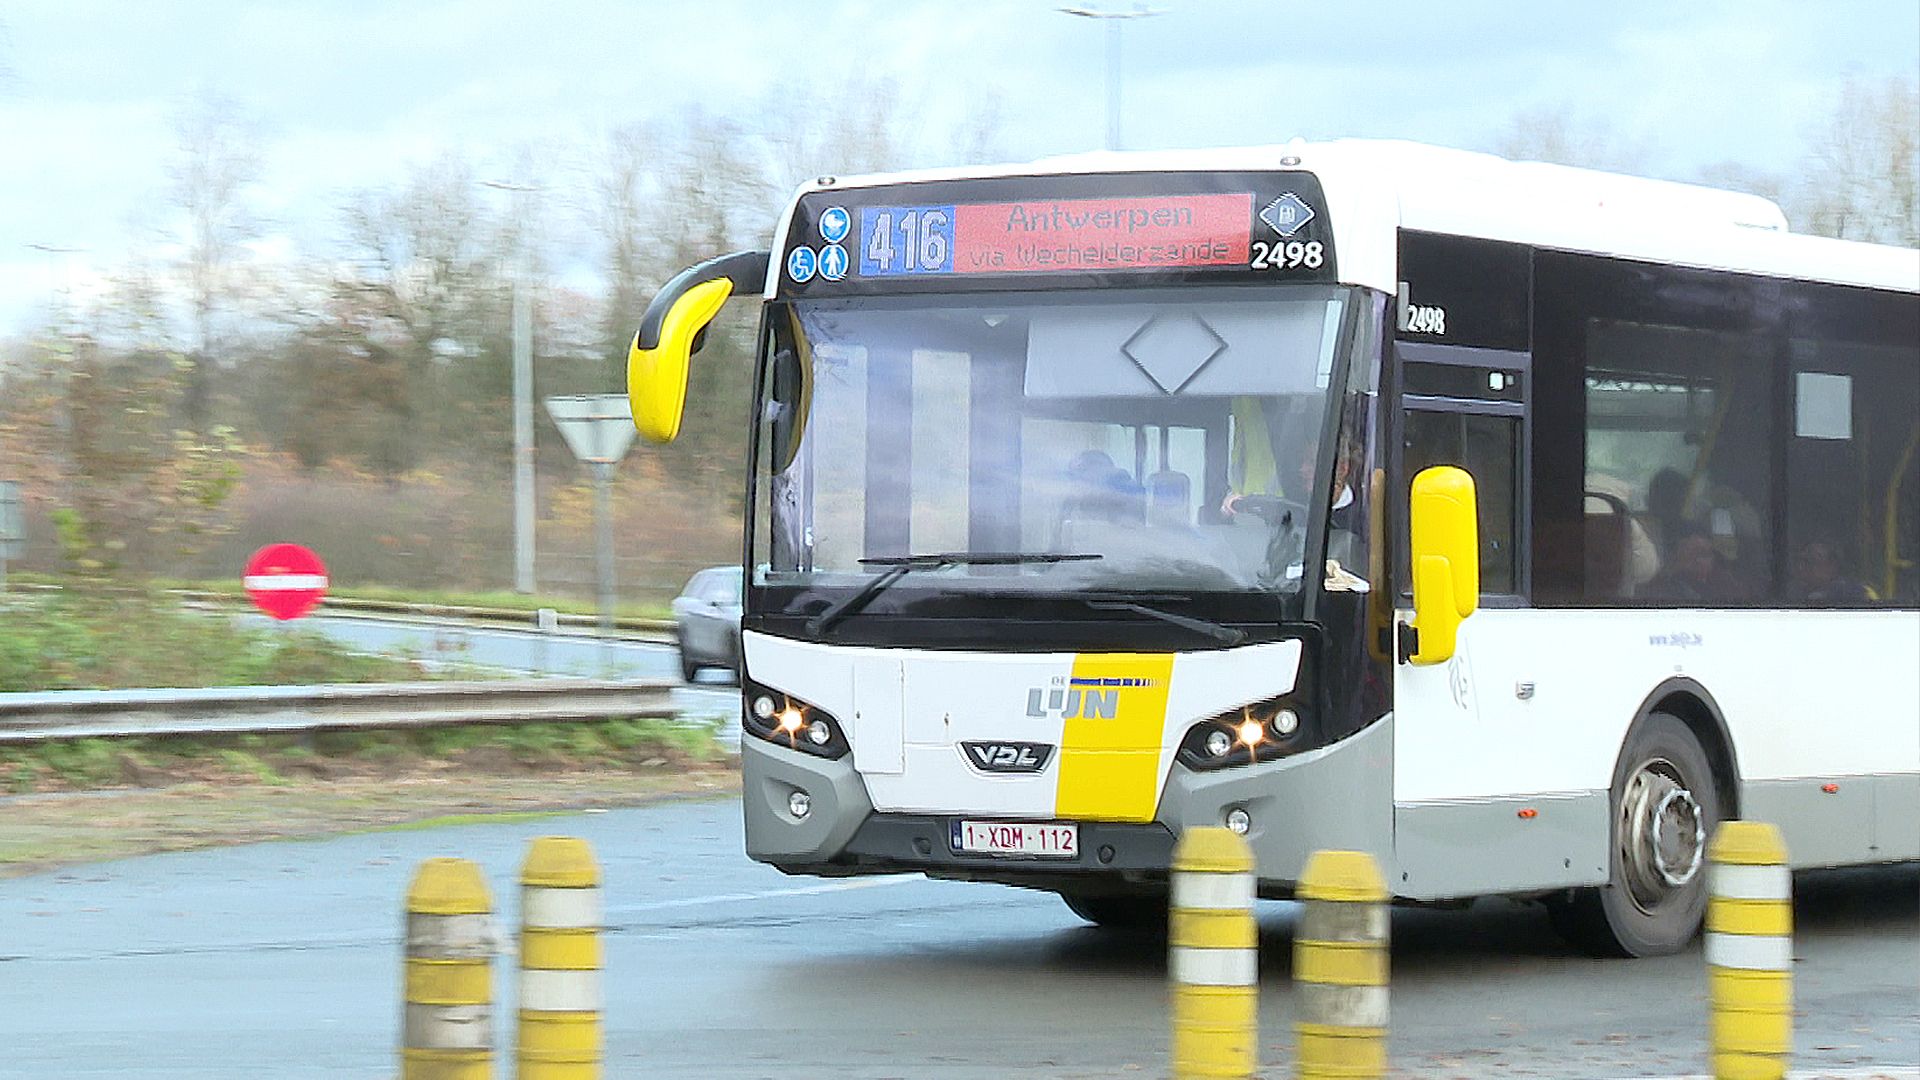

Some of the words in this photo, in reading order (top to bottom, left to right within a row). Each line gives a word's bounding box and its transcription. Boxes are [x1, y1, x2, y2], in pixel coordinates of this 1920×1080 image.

[1007, 204, 1193, 233] Antwerpen
[869, 210, 948, 271] 416
[969, 248, 1005, 267] via
[1017, 237, 1230, 265] Wechelderzande
[1251, 241, 1324, 269] 2498
[1407, 304, 1446, 335] 2498
[972, 745, 1039, 767] VDL
